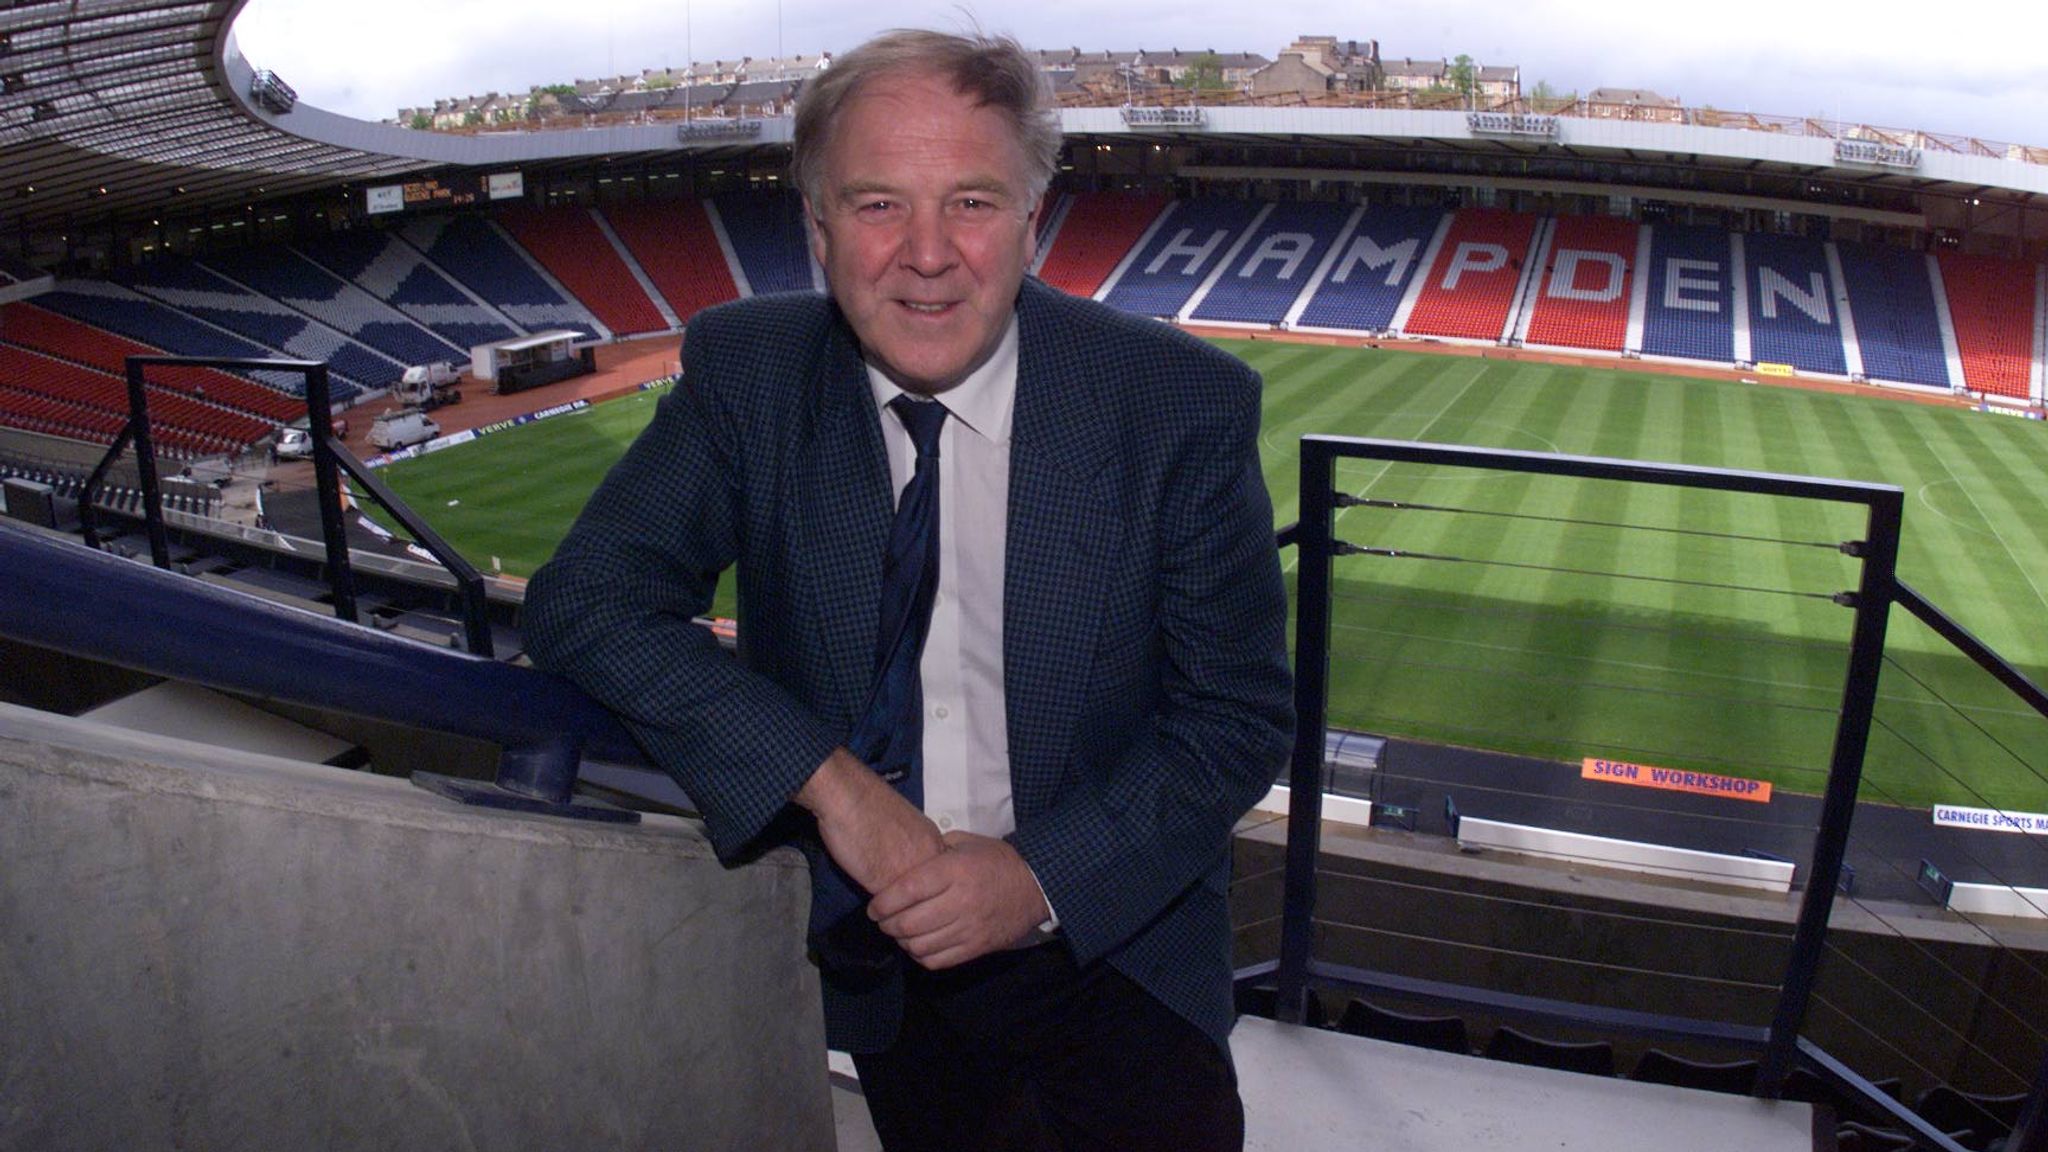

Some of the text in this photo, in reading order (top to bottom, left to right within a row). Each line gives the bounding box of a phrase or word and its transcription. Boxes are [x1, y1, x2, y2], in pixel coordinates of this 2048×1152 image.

[1145, 228, 1831, 325] HAMPDEN
[478, 418, 516, 435] VERVE
[1593, 759, 1760, 794] SIGN WORKSHOP
[1936, 808, 1990, 826] CARNEGIE
[1992, 814, 2032, 830] SPORTS
